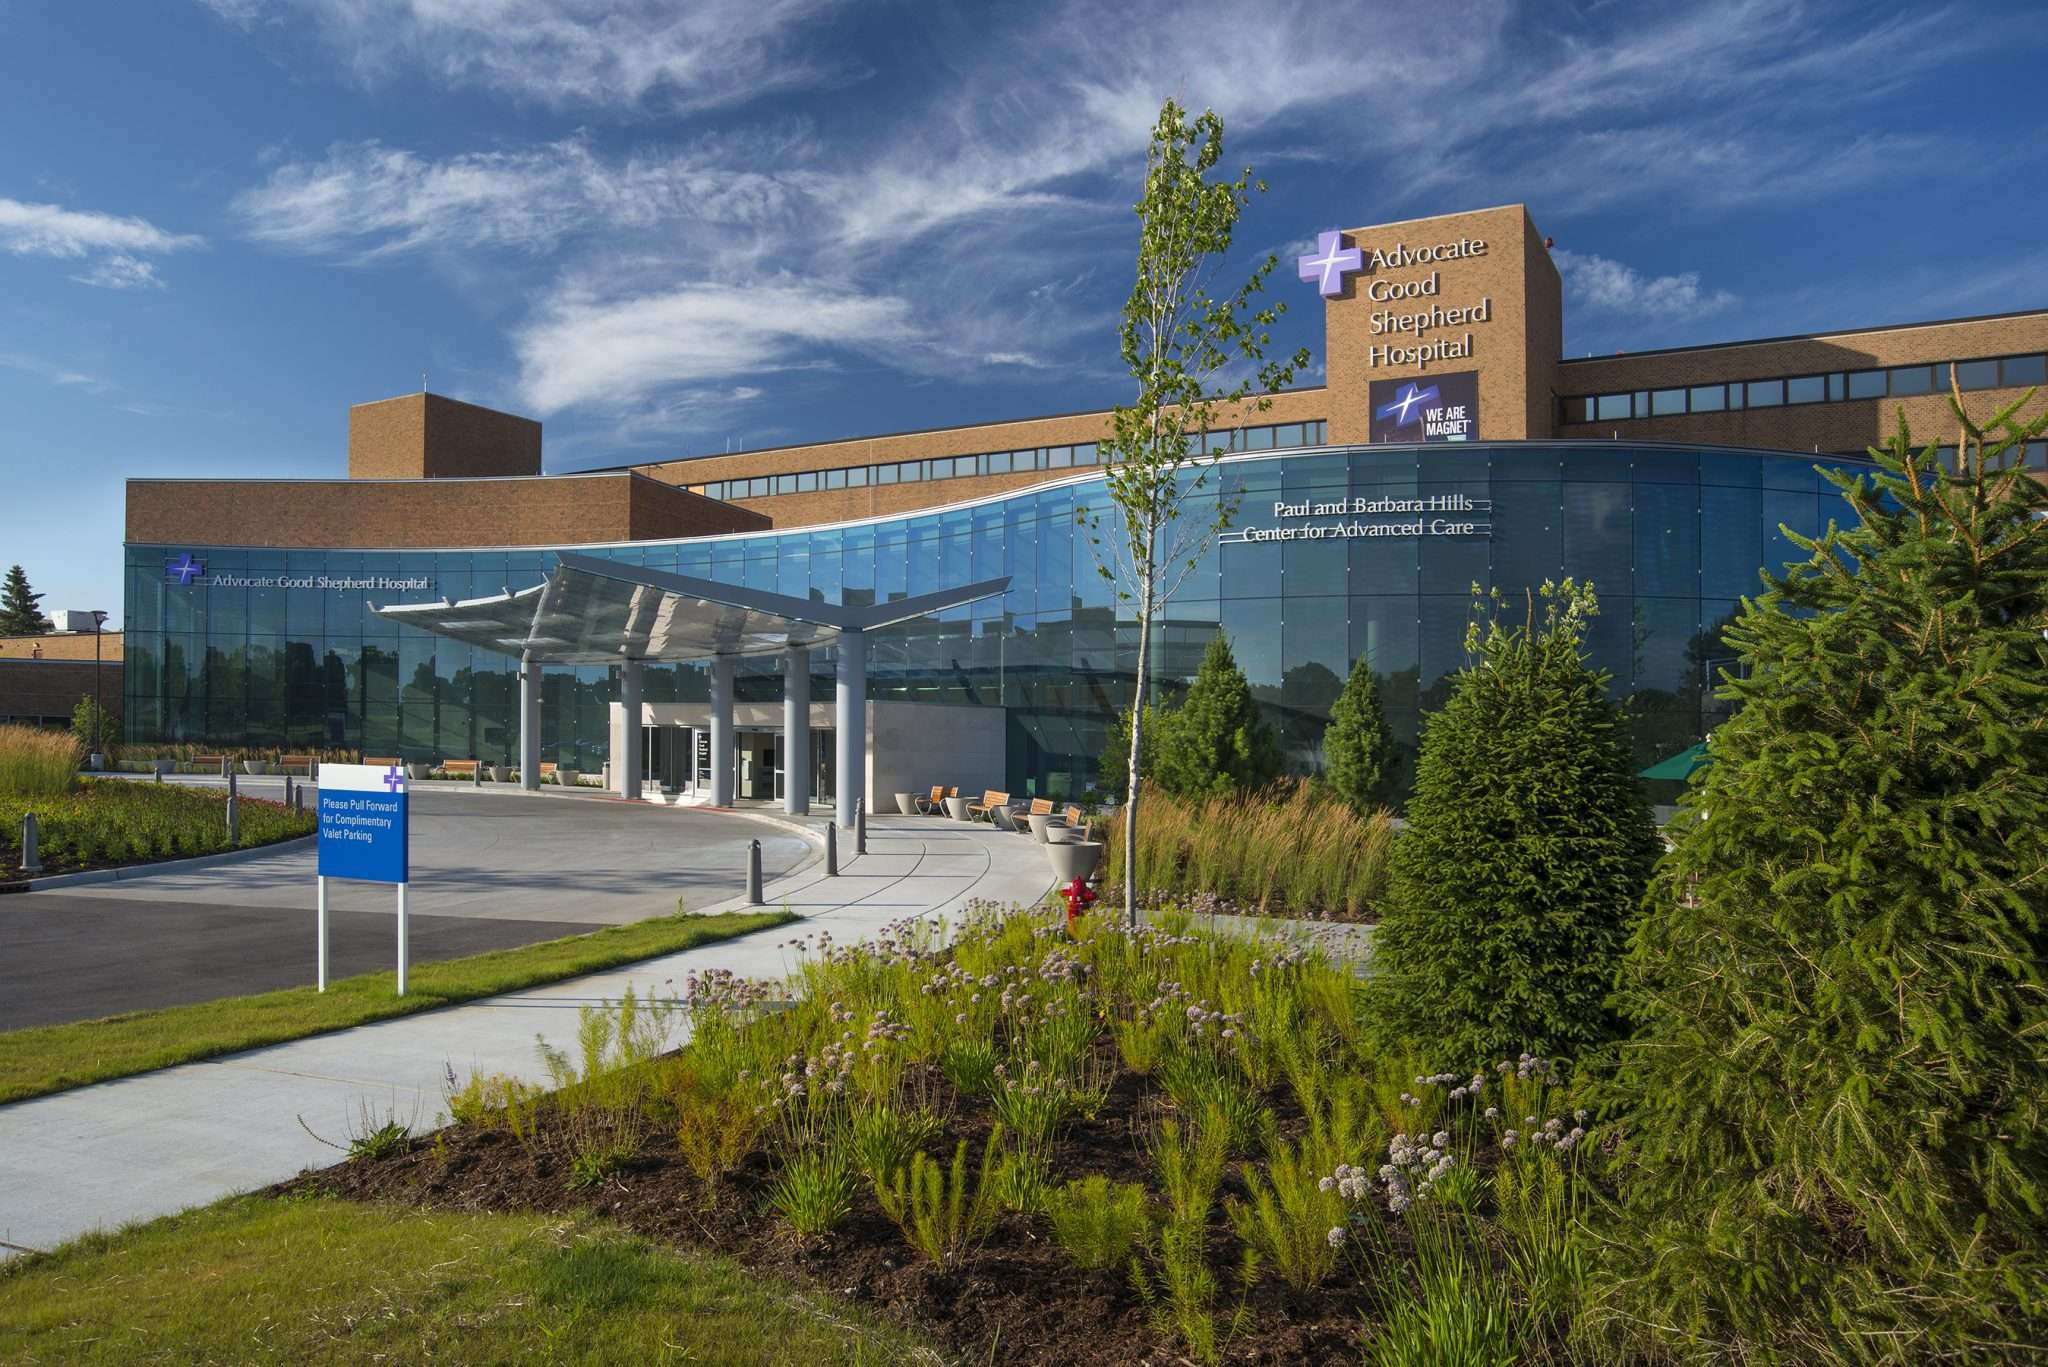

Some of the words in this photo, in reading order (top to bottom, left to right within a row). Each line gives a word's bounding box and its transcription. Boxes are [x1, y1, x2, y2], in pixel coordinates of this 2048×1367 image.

[1368, 238, 1484, 269] Advocate
[1368, 271, 1437, 301] Good
[1369, 298, 1488, 336] Shepherd
[1369, 333, 1470, 368] Hospital
[1425, 408, 1443, 421] WE
[1445, 405, 1466, 420] ARE
[1274, 500, 1310, 517] Paul
[1314, 498, 1347, 515] and
[1355, 496, 1424, 513] Barbara
[1430, 494, 1473, 511] Hills
[1243, 526, 1298, 542] Center
[1303, 523, 1328, 540] for
[1333, 518, 1423, 538] Advanced
[1430, 519, 1474, 535] Care
[213, 574, 273, 588] Advocate
[277, 576, 314, 588] Good
[317, 576, 375, 591] Shepherd
[378, 576, 428, 591] Hospital
[323, 798, 348, 810] Please
[350, 799, 365, 810] Pull
[366, 800, 398, 812] Forward
[323, 812, 333, 824] for
[335, 814, 392, 830] Complimentary
[323, 828, 342, 839] Valet
[344, 829, 373, 843] Parking
